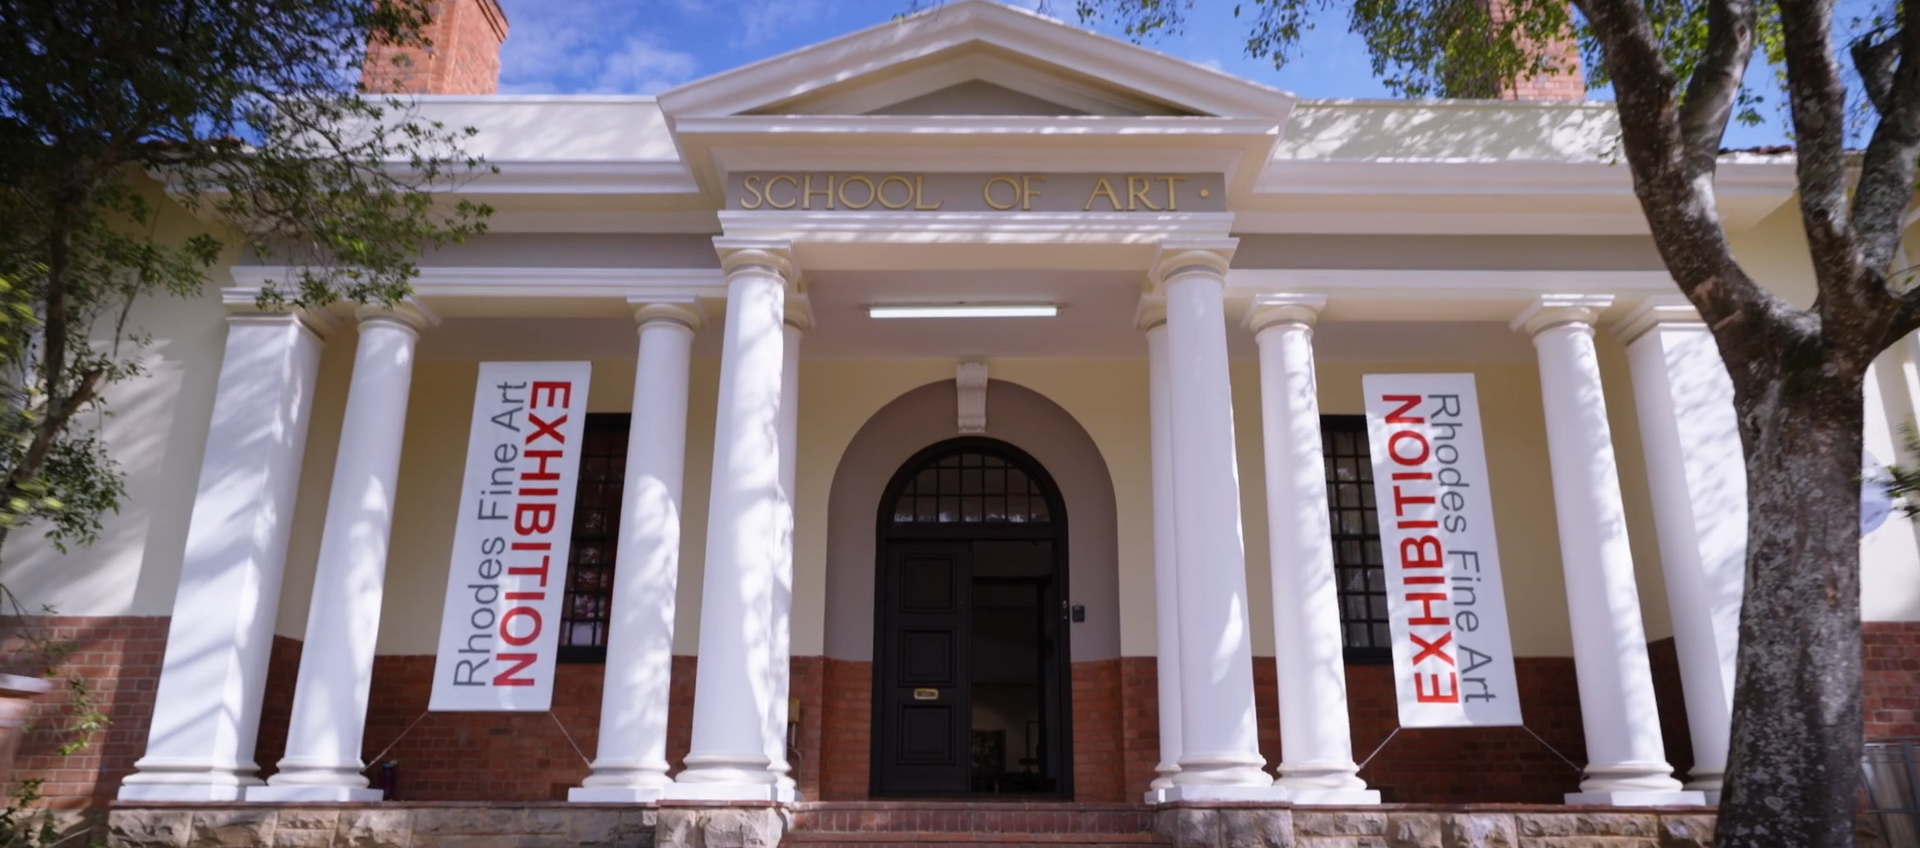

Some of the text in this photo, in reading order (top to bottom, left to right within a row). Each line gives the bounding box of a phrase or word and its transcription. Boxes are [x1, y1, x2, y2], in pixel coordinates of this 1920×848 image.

[740, 175, 943, 211] SCHOOL
[983, 176, 1046, 211] OF
[452, 381, 527, 687] Rhodes Fine Art
[492, 380, 572, 687] EXHIBITION
[1381, 394, 1459, 704] EXHIBITION
[1427, 394, 1497, 704] Rhodes Fine Art
